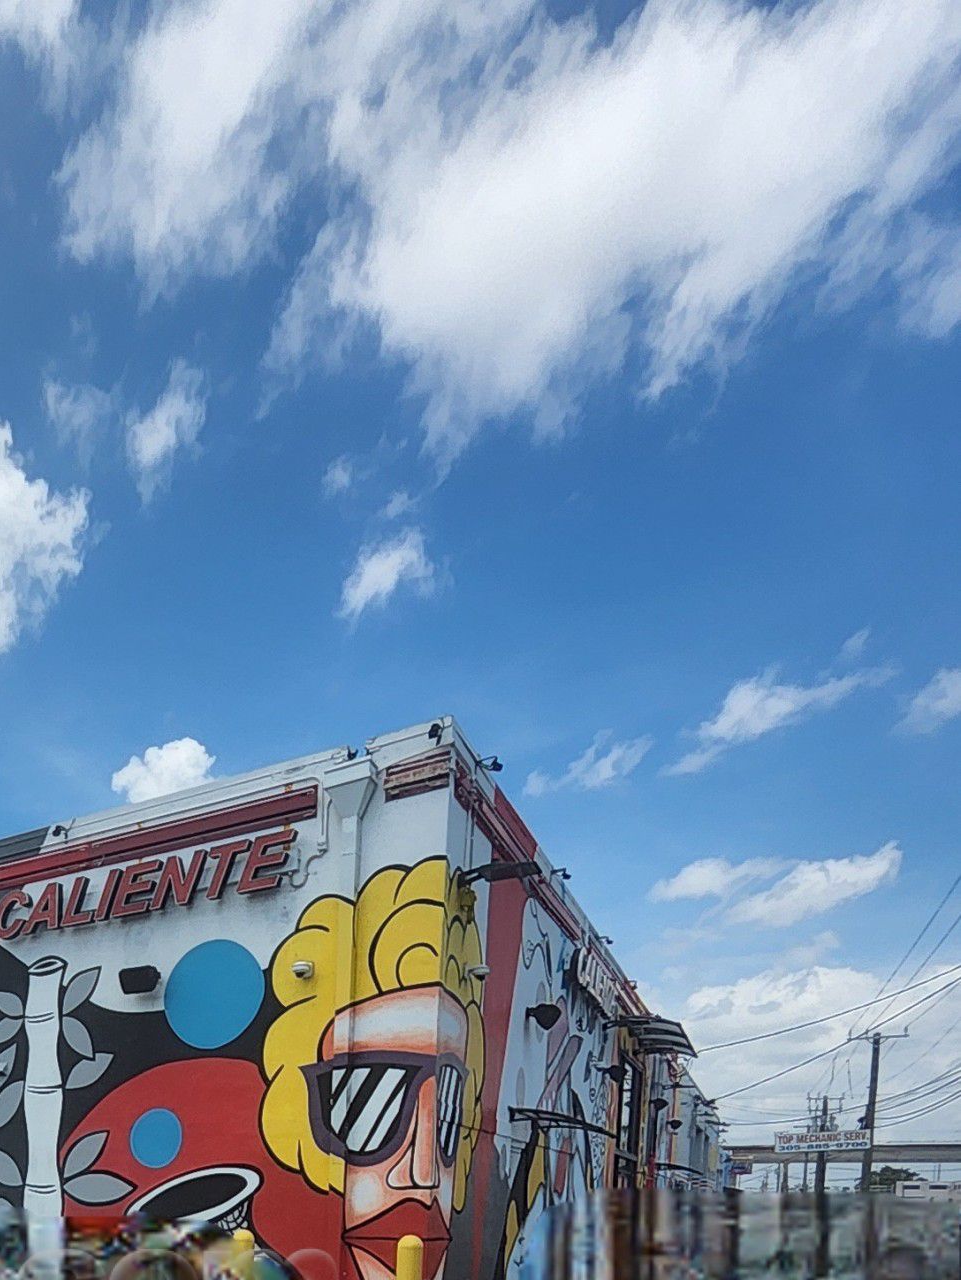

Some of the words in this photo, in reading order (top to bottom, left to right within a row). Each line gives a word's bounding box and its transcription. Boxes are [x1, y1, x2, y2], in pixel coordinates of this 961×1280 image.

[777, 1134, 794, 1145] TOP
[796, 1132, 842, 1143] MECHANIC
[843, 1130, 870, 1141] SERV.
